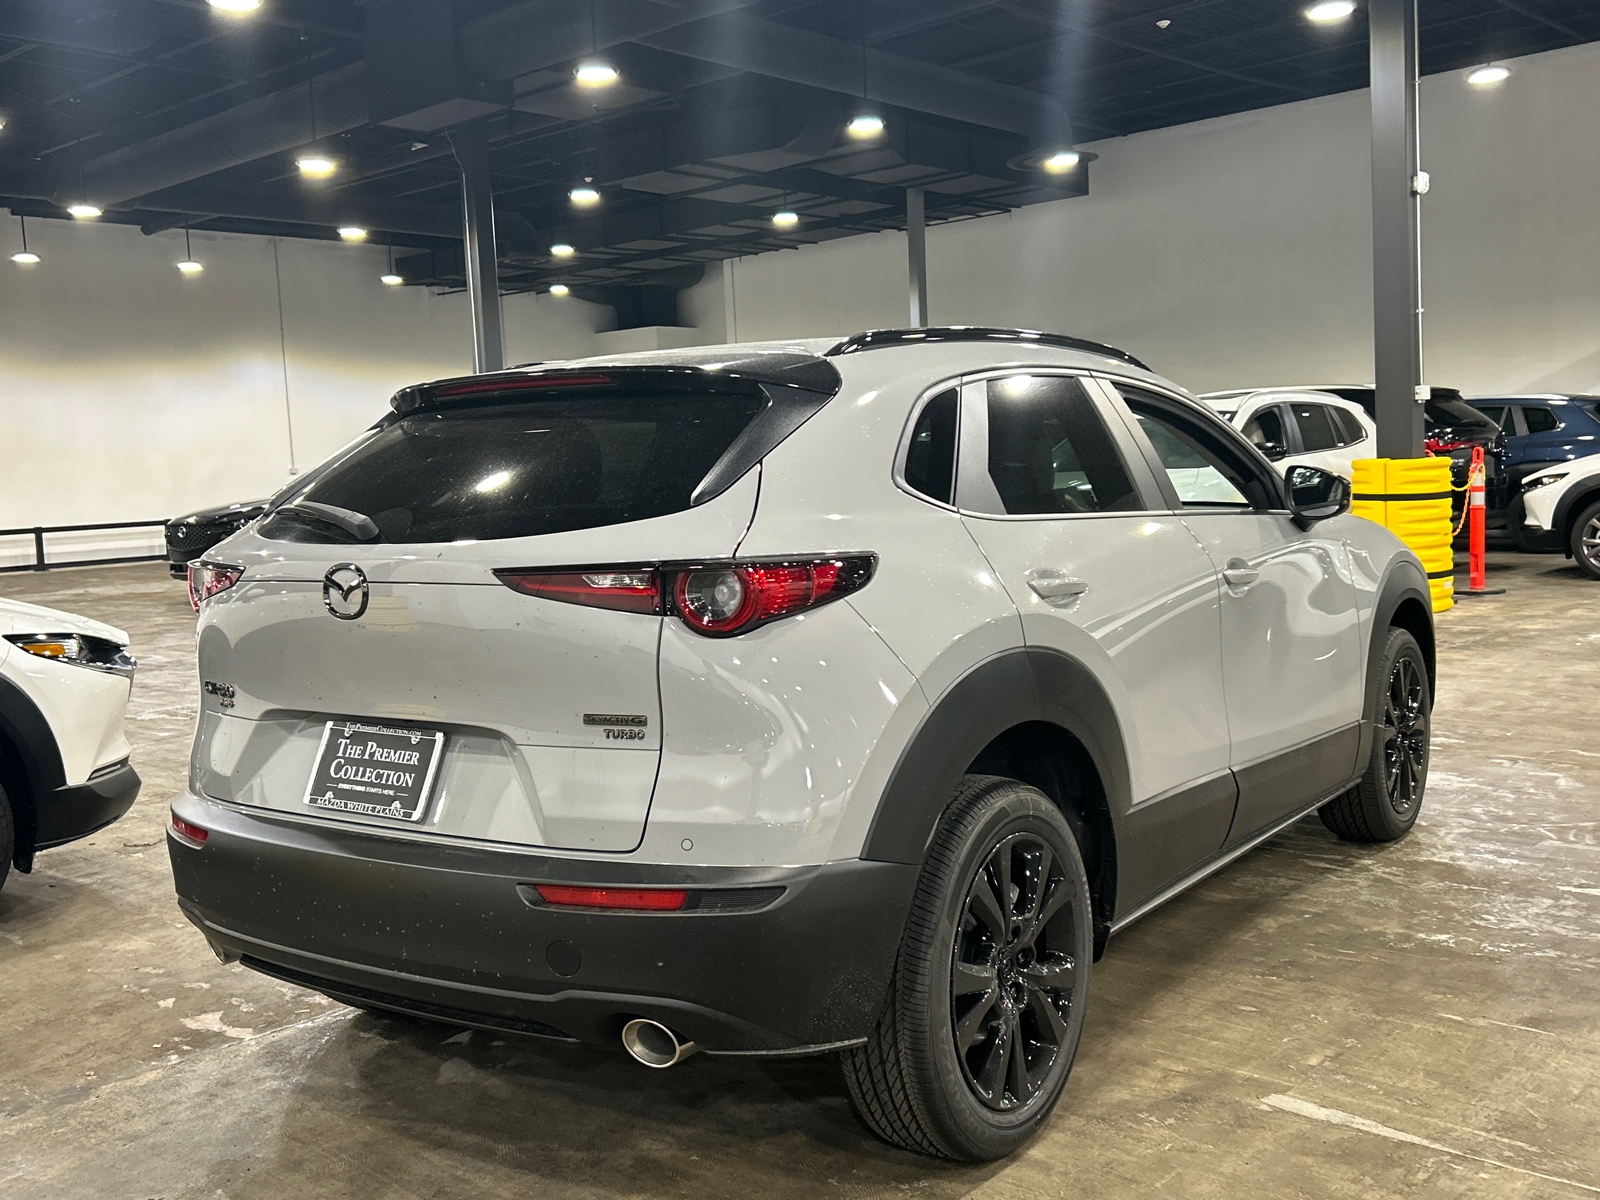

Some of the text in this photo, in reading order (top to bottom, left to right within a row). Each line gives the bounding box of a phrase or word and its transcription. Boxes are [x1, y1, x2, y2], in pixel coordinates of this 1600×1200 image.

[603, 728, 646, 740] TURBO
[336, 738, 420, 766] THE PREMIER
[329, 758, 415, 787] COLLECTION
[337, 783, 366, 792] EVERYTHING
[316, 798, 404, 818] MAZDA WHITE PLAINS
